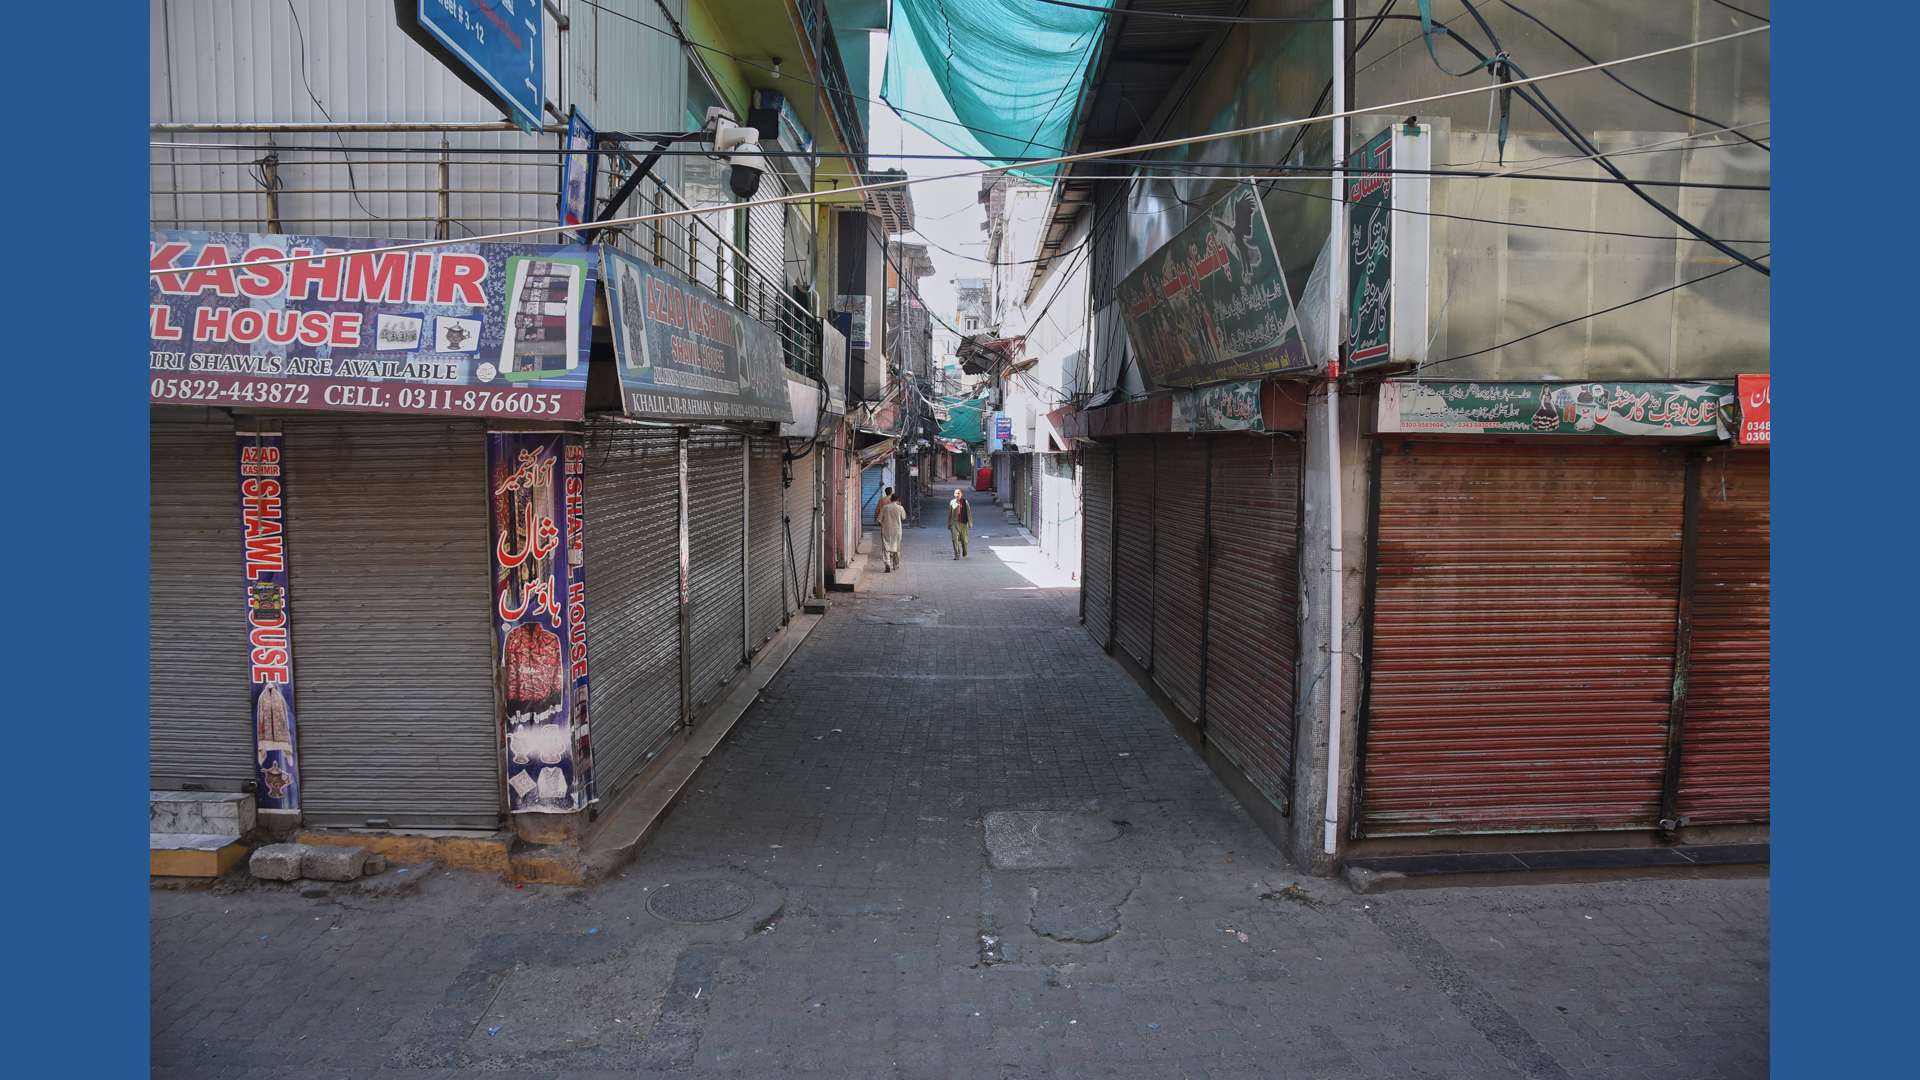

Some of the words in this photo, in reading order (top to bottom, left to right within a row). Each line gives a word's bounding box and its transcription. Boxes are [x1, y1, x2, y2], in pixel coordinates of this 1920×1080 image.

[150, 241, 488, 306] KASHMIR
[193, 307, 363, 347] HOUSE
[645, 273, 685, 330] AZAD
[686, 293, 735, 348] KASHMIR
[189, 353, 282, 374] SHAWLS
[286, 357, 333, 378] ARE
[335, 357, 459, 381] AVAILABLE
[671, 335, 701, 367] SHAWL
[702, 345, 726, 373] HOUSE
[150, 377, 310, 404] 05822-443872
[323, 384, 391, 408] CELL:
[398, 387, 561, 414] 0311-8766055
[1594, 385, 1650, 424] گارمنٹس
[241, 447, 279, 464] AZAD
[241, 464, 280, 476] KASHMIR
[565, 445, 584, 462] AZAD
[242, 478, 284, 580] SHAWL
[497, 502, 559, 567] شال
[499, 575, 562, 628] ہاؤس
[569, 582, 588, 682] HOUSE
